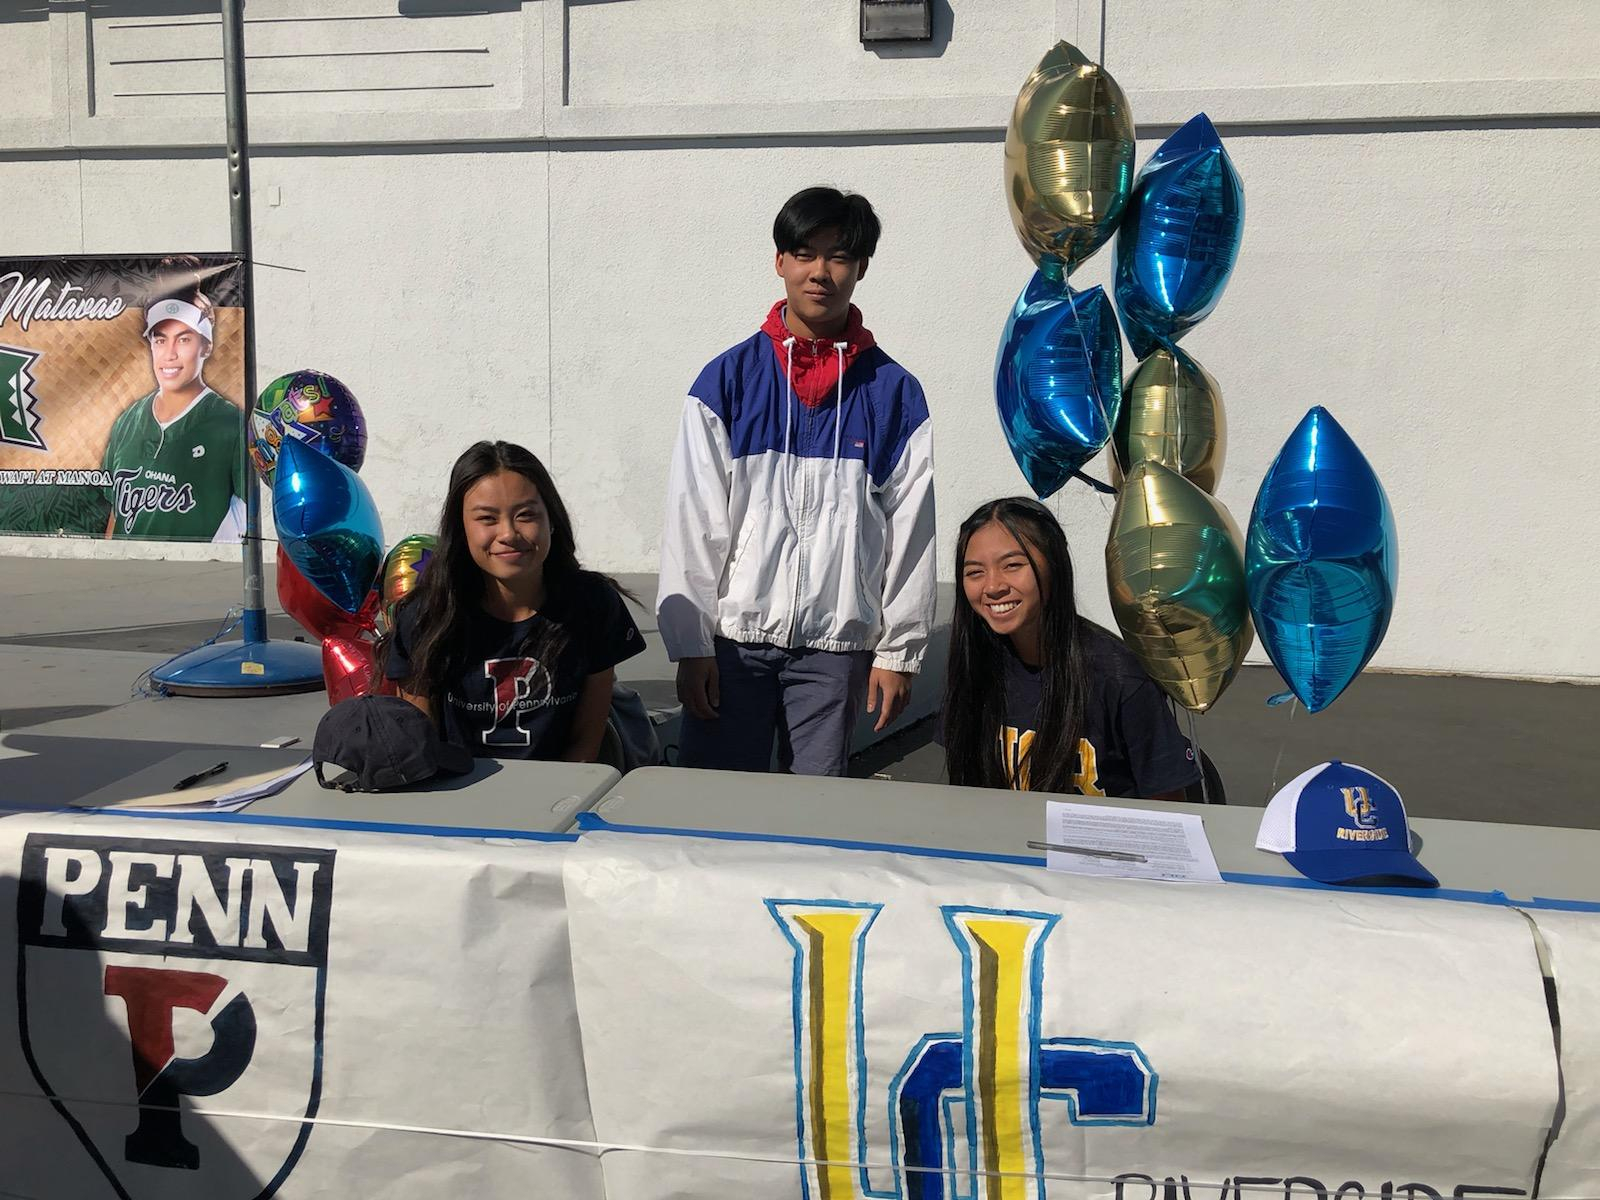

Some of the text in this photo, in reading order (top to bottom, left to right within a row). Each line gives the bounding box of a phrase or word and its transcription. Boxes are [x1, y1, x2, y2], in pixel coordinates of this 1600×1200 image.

[35, 470, 56, 485] AT
[56, 470, 113, 486] MANOA
[145, 470, 176, 484] OHANA
[113, 465, 196, 534] Tigers
[447, 691, 496, 714] University
[498, 699, 511, 712] of
[40, 847, 320, 952] PENN
